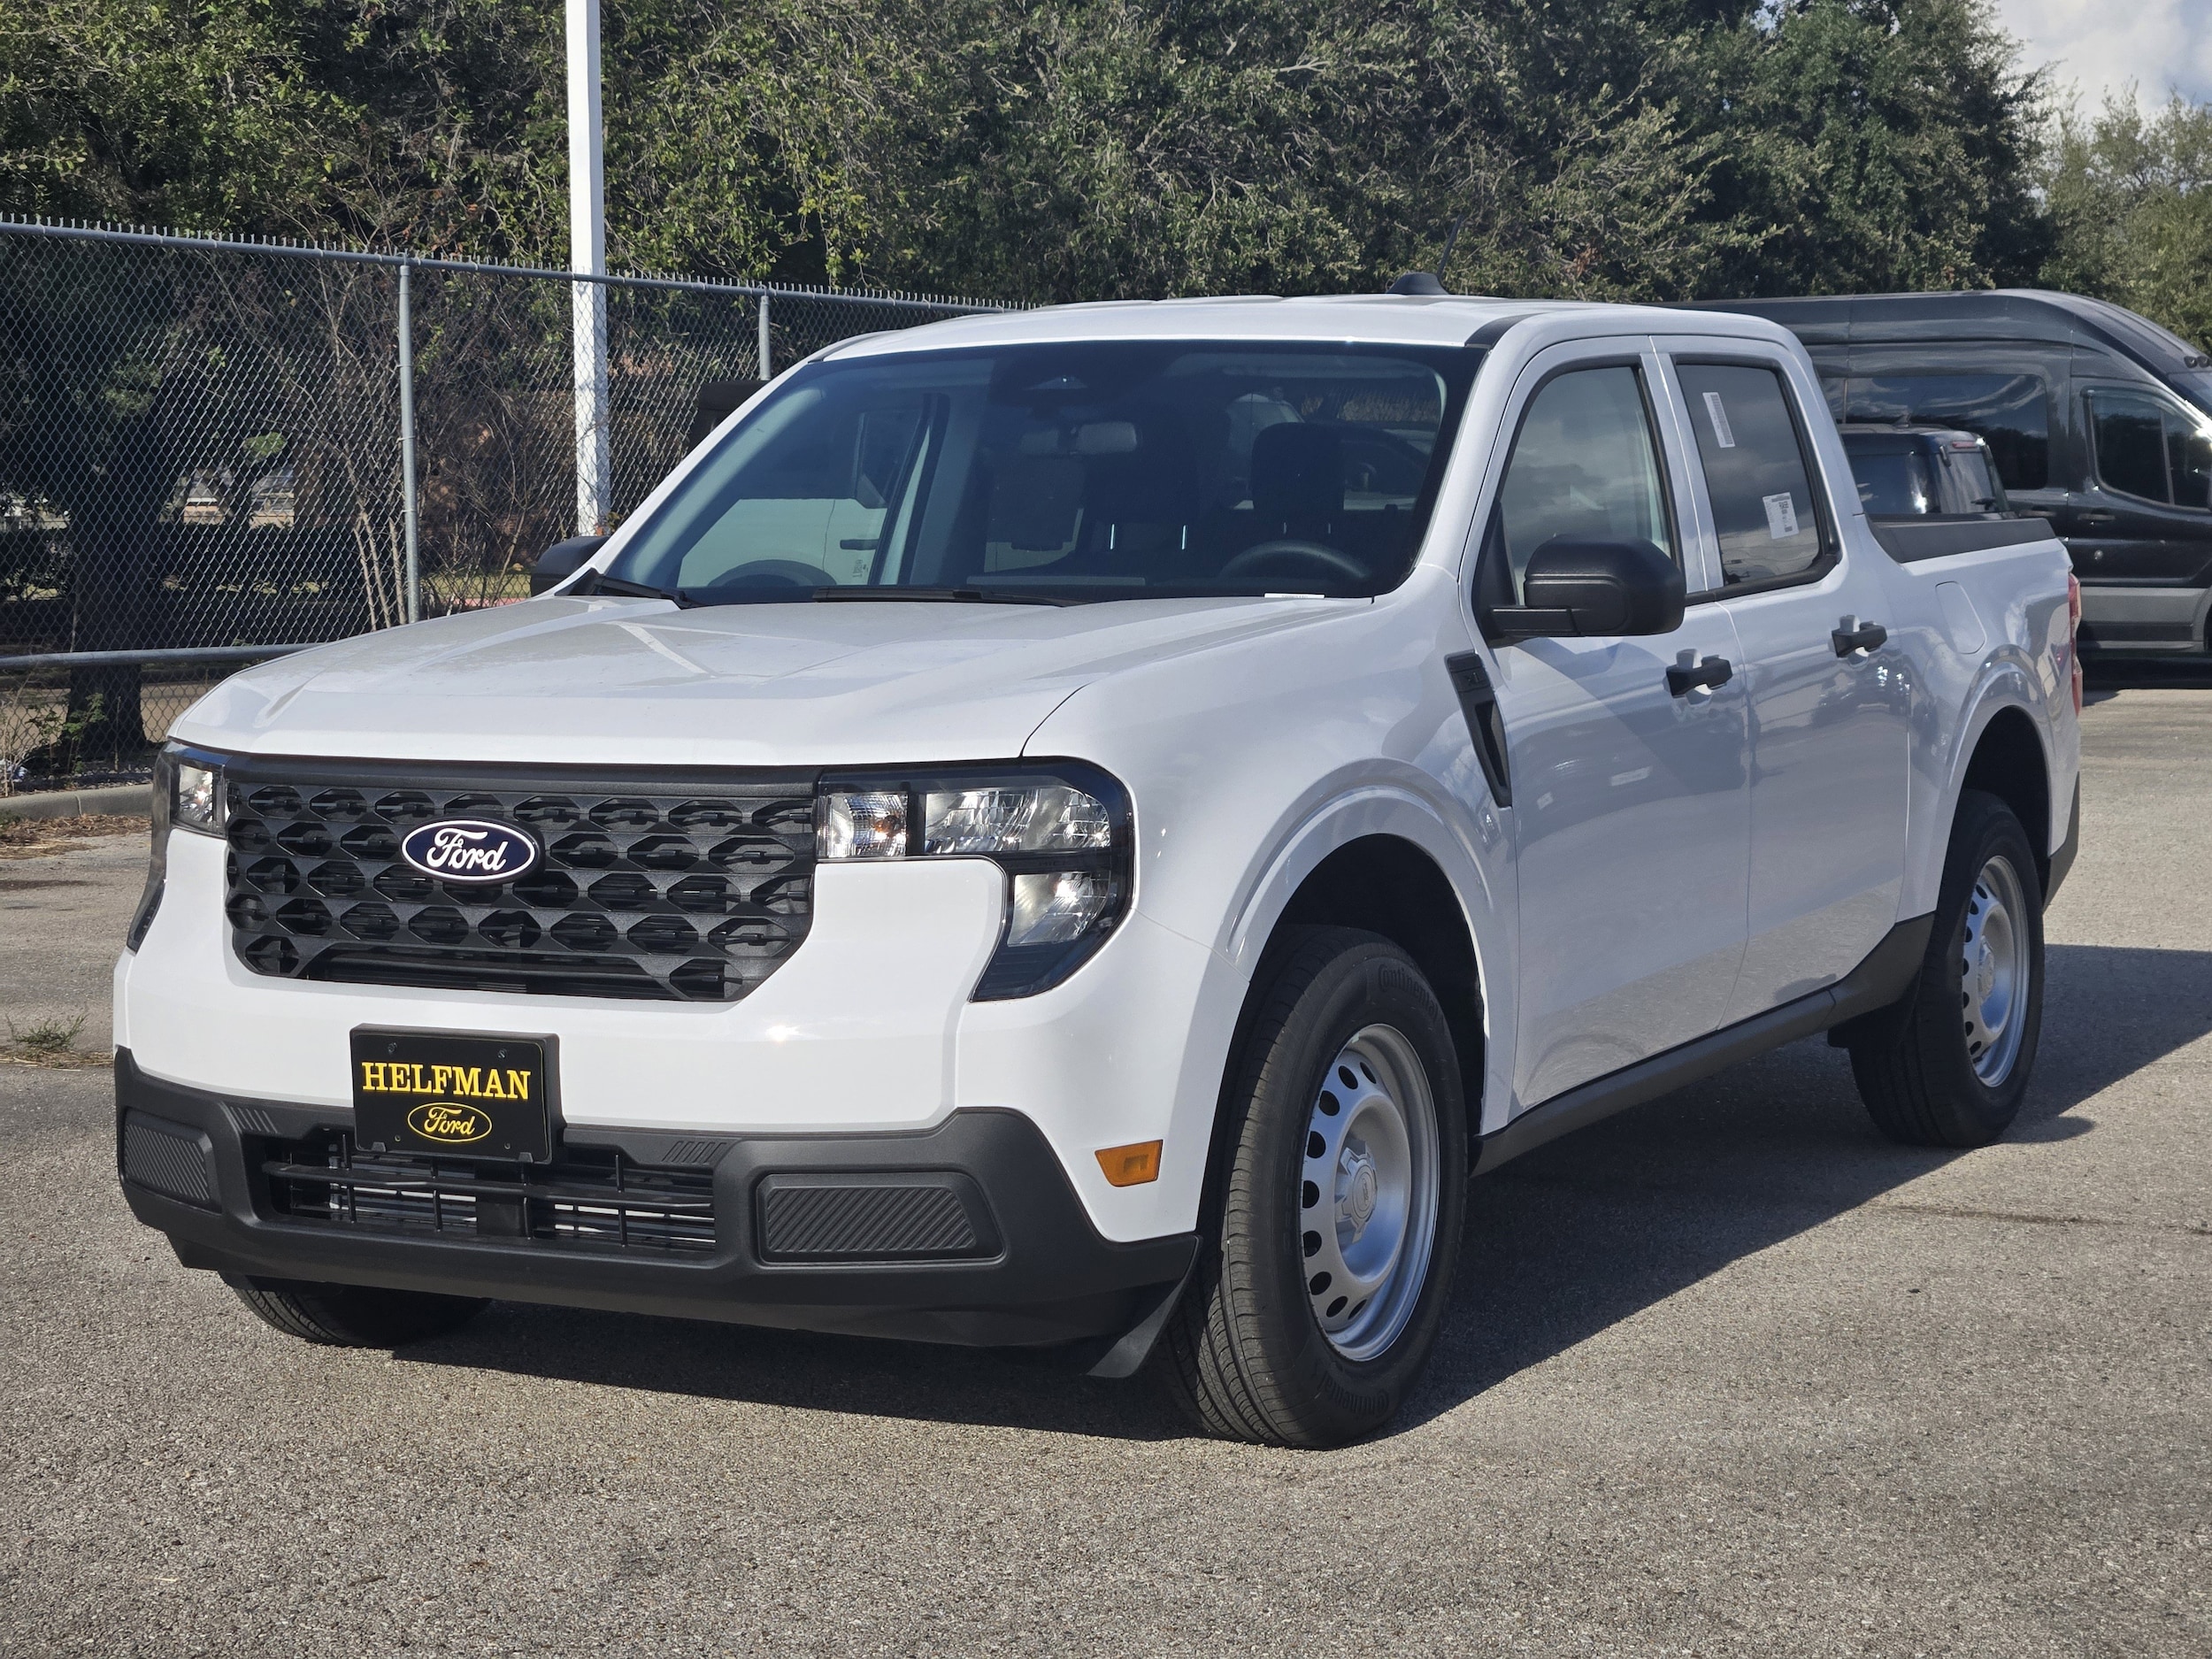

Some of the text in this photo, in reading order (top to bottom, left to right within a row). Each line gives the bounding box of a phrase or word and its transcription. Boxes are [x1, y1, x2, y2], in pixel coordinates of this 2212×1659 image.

[426, 828, 508, 872] Ford
[1378, 964, 1439, 1024] Continental
[361, 1062, 531, 1100] HELFMAN
[424, 1107, 475, 1135] Ford
